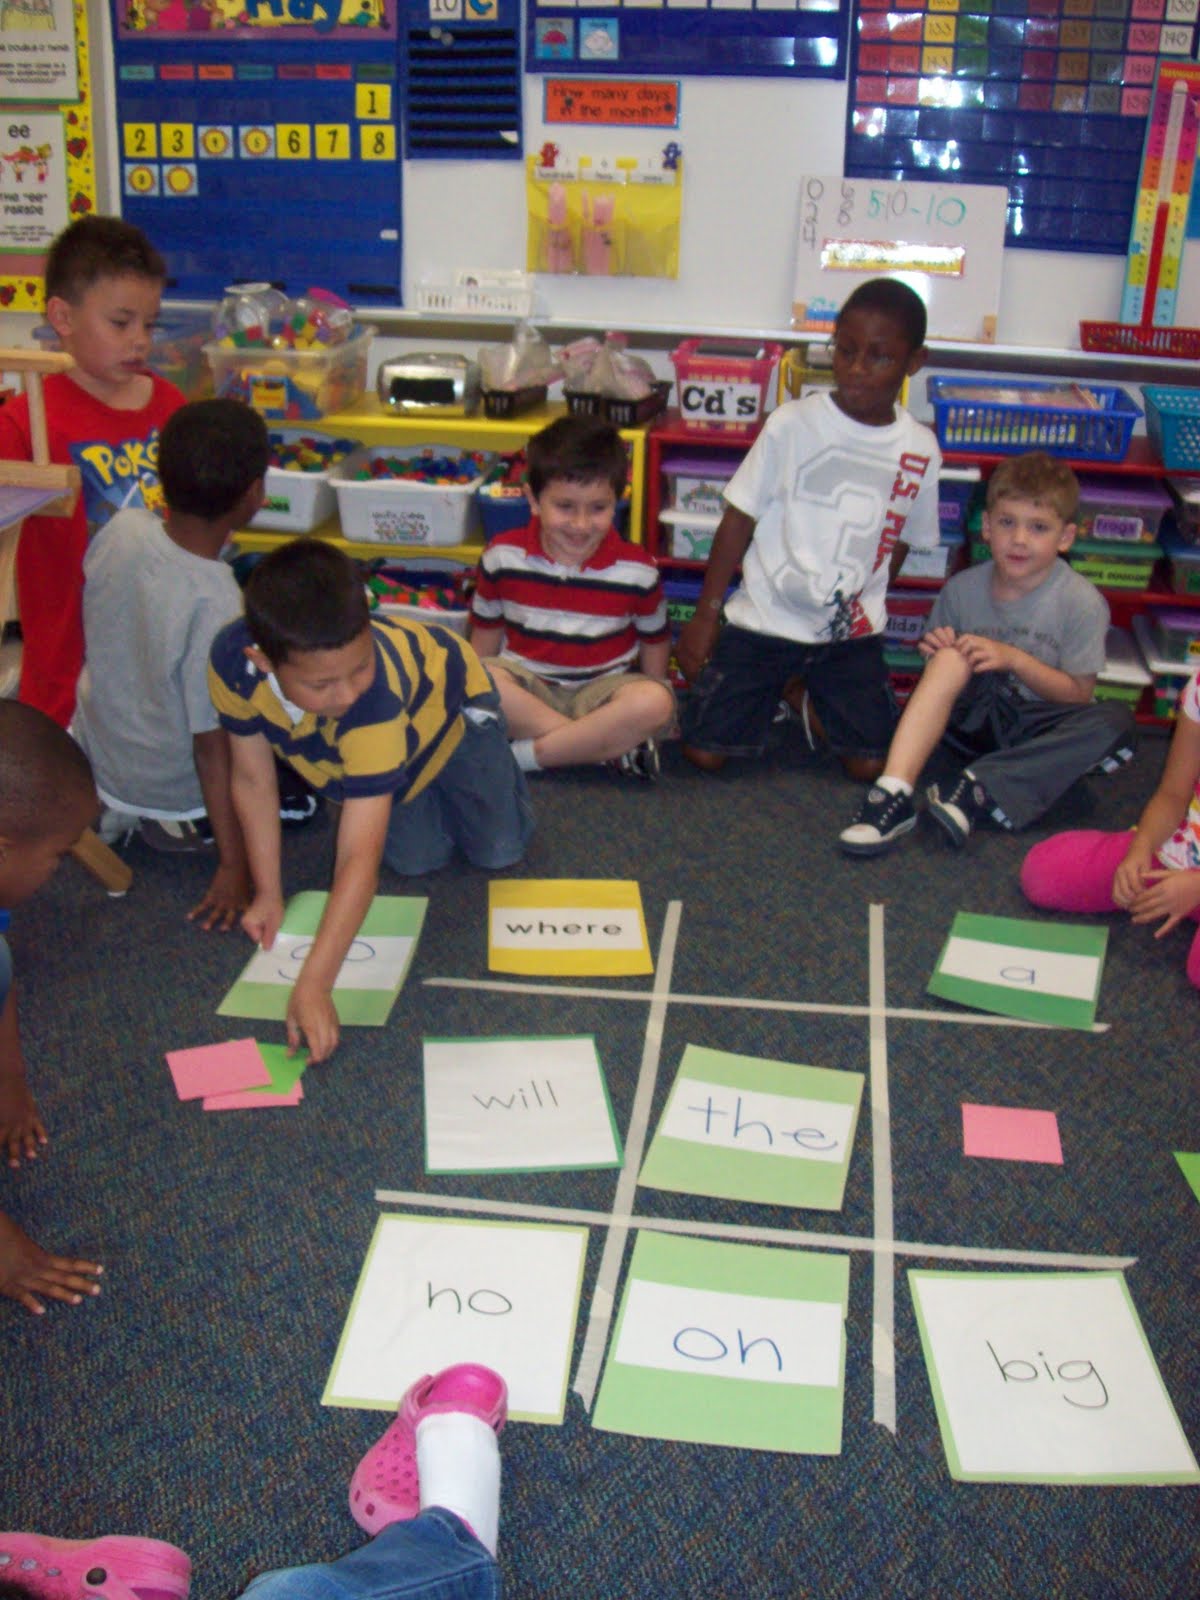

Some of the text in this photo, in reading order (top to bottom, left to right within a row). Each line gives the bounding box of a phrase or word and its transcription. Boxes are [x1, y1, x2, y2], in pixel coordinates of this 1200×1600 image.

[1164, 31, 1188, 47] 140
[367, 90, 376, 115] 1
[553, 87, 670, 101] How many days
[580, 104, 601, 117] the
[609, 106, 663, 118] month?
[8, 124, 30, 138] ee
[135, 129, 147, 152] 2
[172, 130, 184, 153] 3
[288, 130, 300, 154] 6
[327, 129, 338, 154] 7
[373, 132, 384, 154] 8
[807, 178, 824, 200] 0
[682, 385, 757, 416] Cd's
[505, 920, 623, 936] where
[1000, 965, 1036, 984] a
[473, 1079, 559, 1112] will
[688, 1096, 838, 1150] the
[427, 1281, 513, 1316] no
[673, 1326, 783, 1372] on
[986, 1339, 1109, 1409] big
